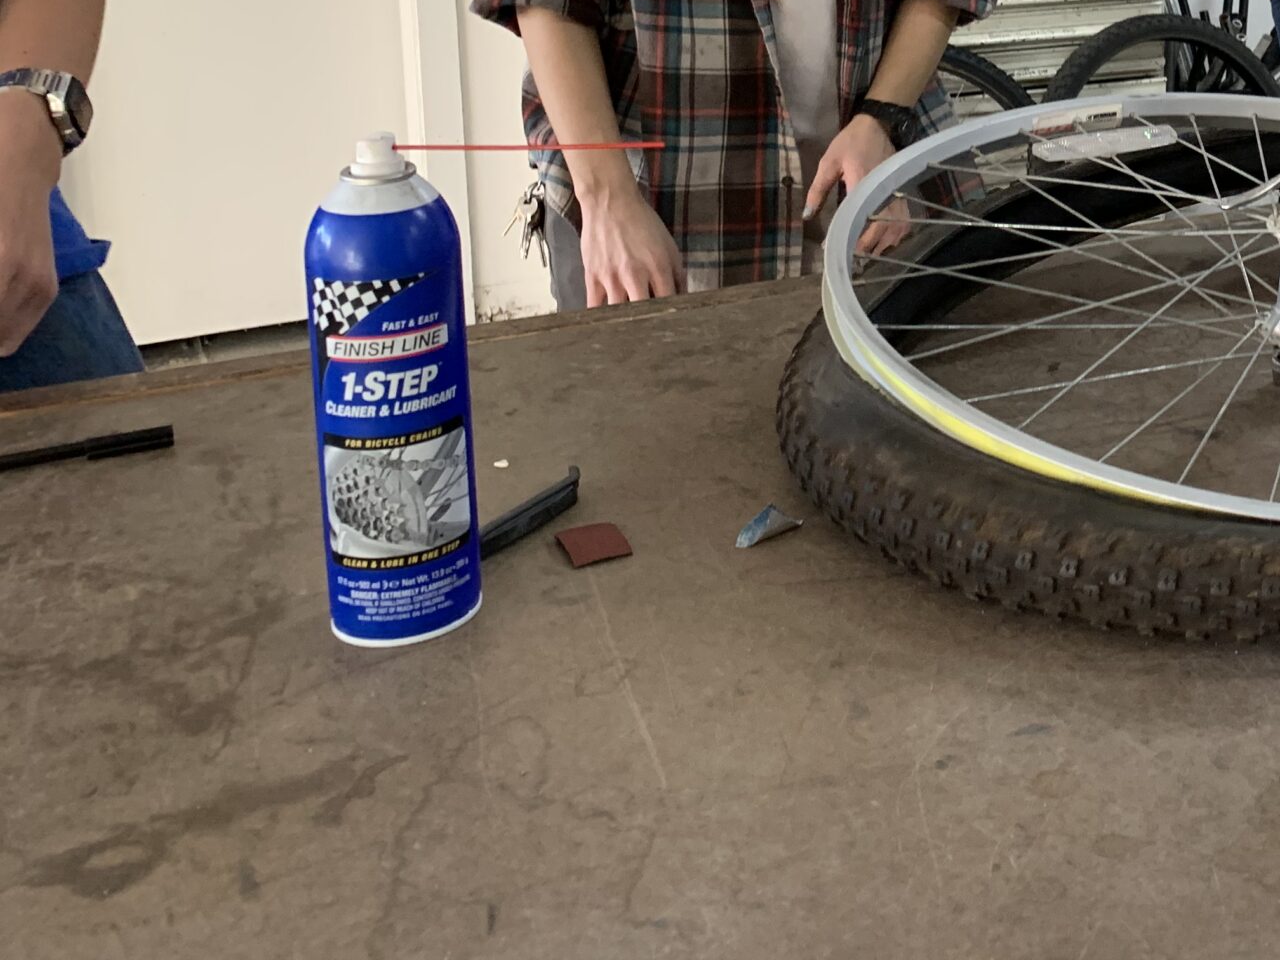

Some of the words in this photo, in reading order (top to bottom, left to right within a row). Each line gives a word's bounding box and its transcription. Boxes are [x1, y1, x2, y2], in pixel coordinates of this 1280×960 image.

[382, 320, 405, 332] FAST
[408, 319, 415, 328] &
[418, 312, 439, 325] EASY
[333, 341, 395, 357] FINISH
[401, 329, 442, 352] LINE
[341, 364, 439, 402] 1-STEP
[325, 400, 377, 418] CLEANER
[379, 405, 391, 416] &
[393, 385, 457, 416] LUBRICANT
[345, 439, 362, 448] FOR
[365, 434, 406, 448] BICYCLE
[342, 558, 368, 568] CLEAN
[380, 558, 404, 569] LUBE
[408, 555, 418, 565] IN
[421, 549, 439, 563] ONE
[442, 540, 460, 556] STEP
